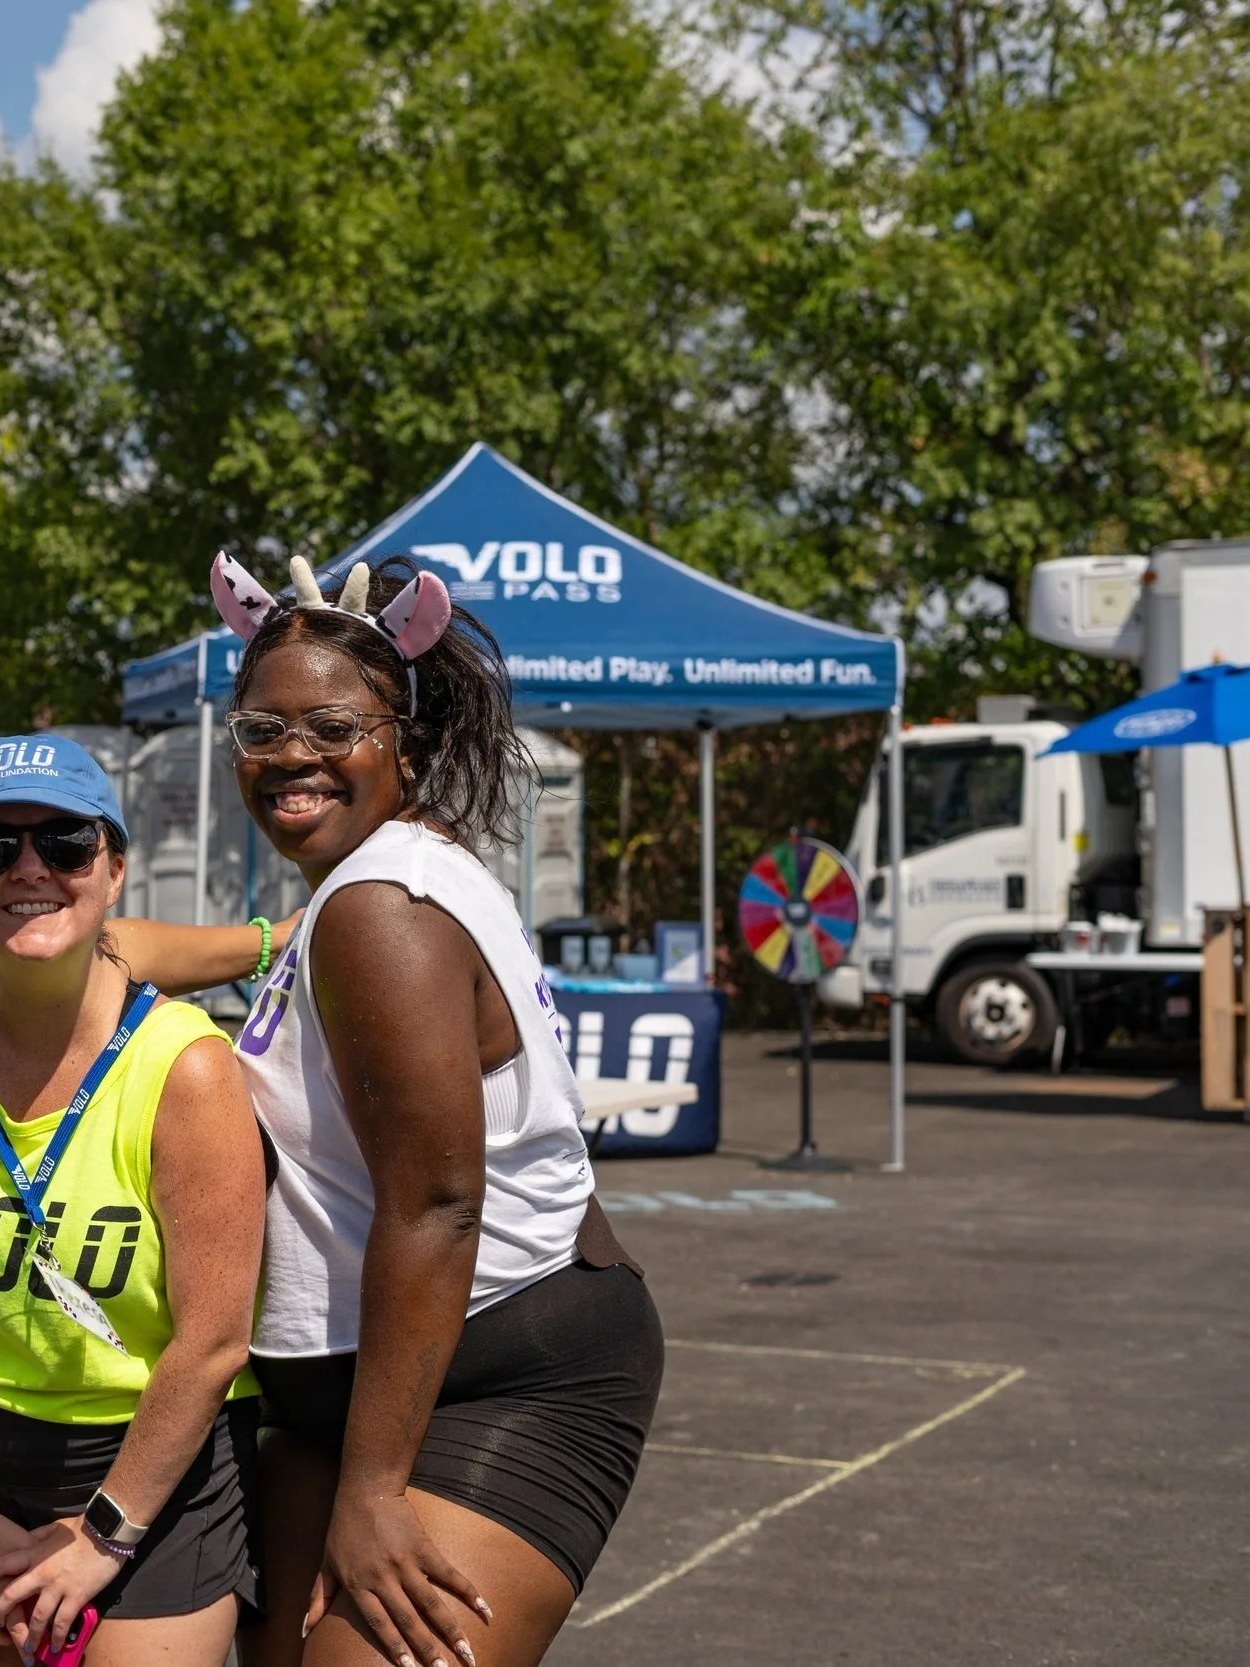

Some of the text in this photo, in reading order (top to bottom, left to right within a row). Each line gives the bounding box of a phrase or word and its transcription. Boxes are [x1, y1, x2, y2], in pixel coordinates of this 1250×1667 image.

[410, 540, 623, 584] VOLO
[503, 581, 623, 603] PASS
[500, 654, 878, 687] limited Play. Unlimited Fun.
[106, 1026, 131, 1052] VOLO
[67, 1088, 90, 1115] VOLO
[11, 1163, 30, 1191] VOLO
[34, 1155, 55, 1183] VOLO
